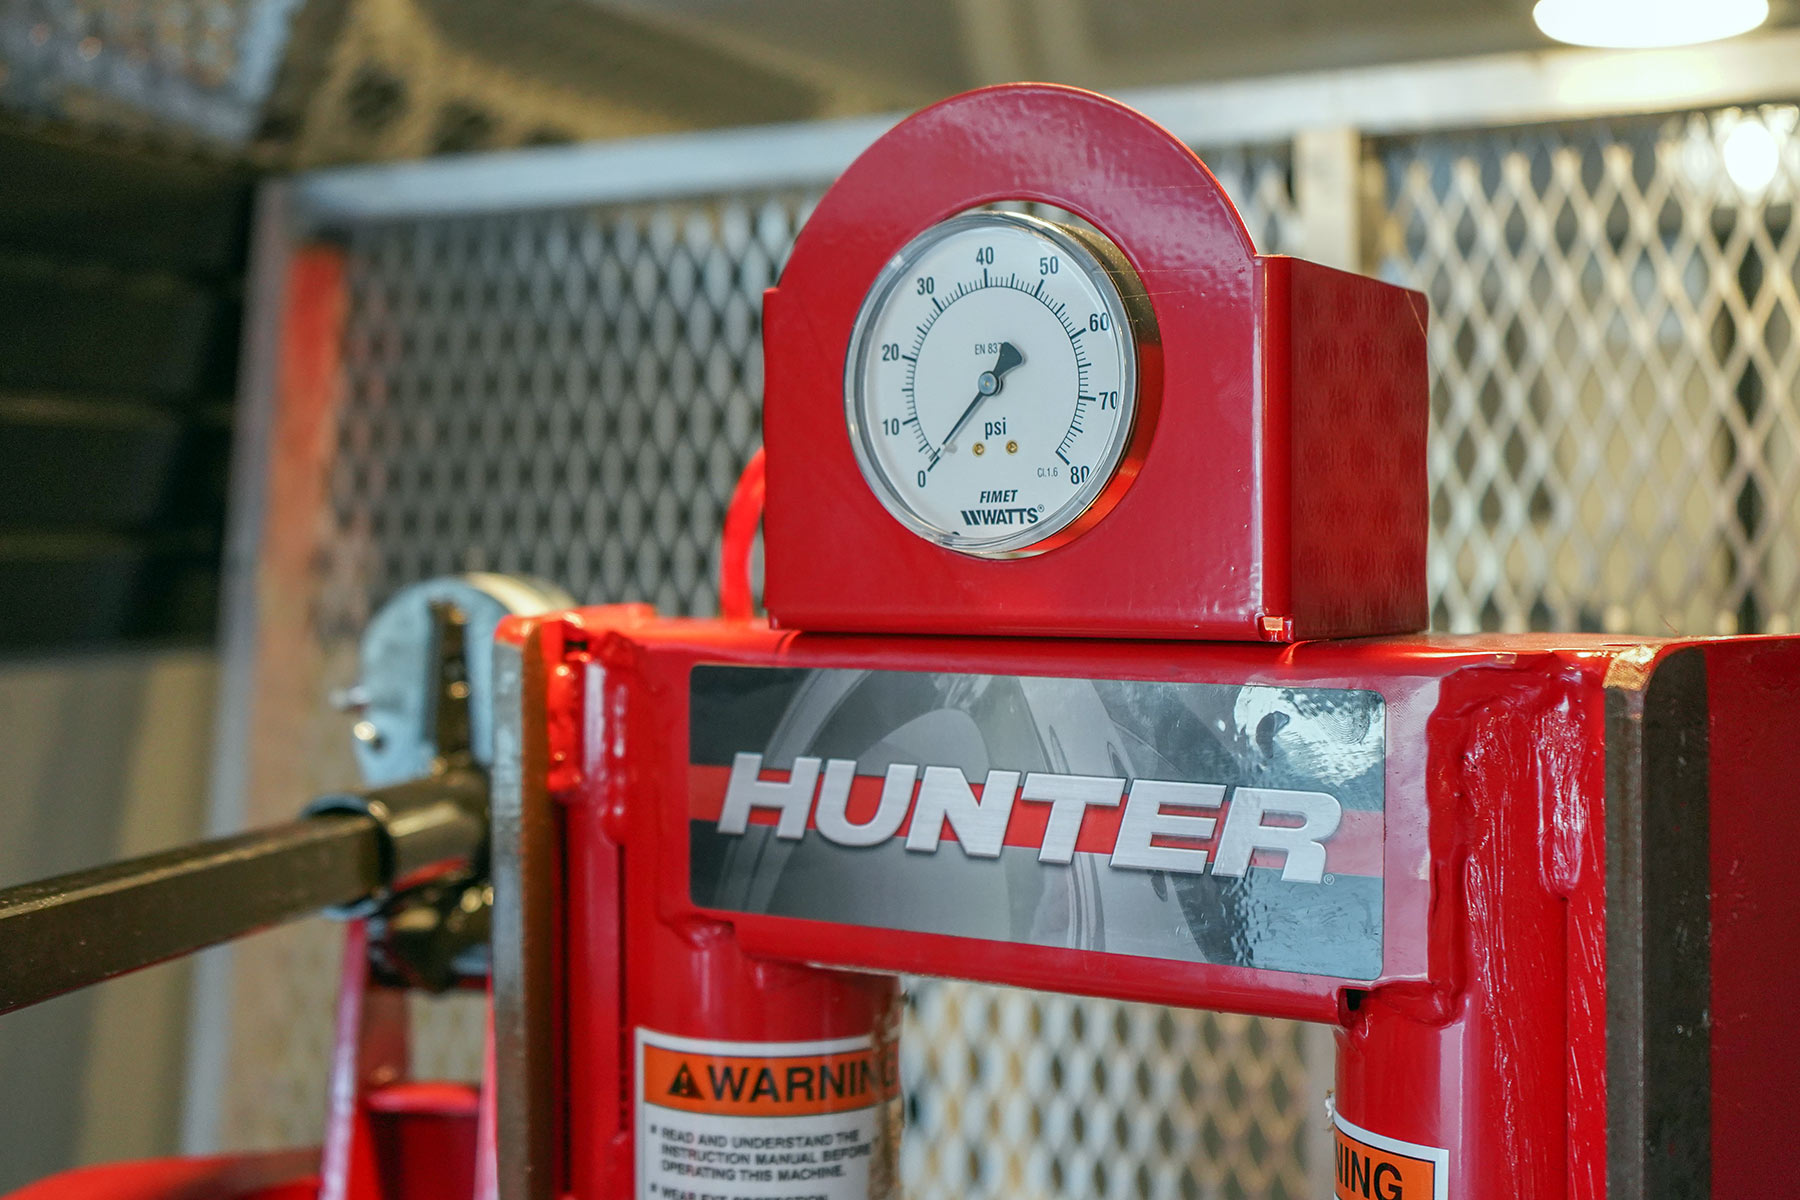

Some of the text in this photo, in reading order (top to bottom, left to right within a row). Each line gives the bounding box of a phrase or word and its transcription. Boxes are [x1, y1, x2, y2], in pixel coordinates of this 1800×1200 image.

[976, 247, 994, 265] 40
[1040, 256, 1059, 276] 50
[917, 276, 935, 296] 30
[1089, 312, 1110, 332] 60
[882, 343, 900, 362] 20
[974, 344, 986, 355] EN
[1099, 391, 1118, 410] 70
[882, 418, 900, 436] 10
[984, 417, 1007, 440] psi
[917, 470, 927, 488] 0
[1070, 465, 1090, 485] 80
[979, 489, 1019, 504] FIMET
[716, 752, 1342, 885] HUNTER
[707, 1051, 897, 1103] WARNING
[661, 1127, 859, 1149] READ AND UNDERSTAND THE
[661, 1143, 872, 1165] INSTRUCTION MANUAL BEFORE
[661, 1159, 736, 1181] OPERATING
[738, 1169, 773, 1181] THIS
